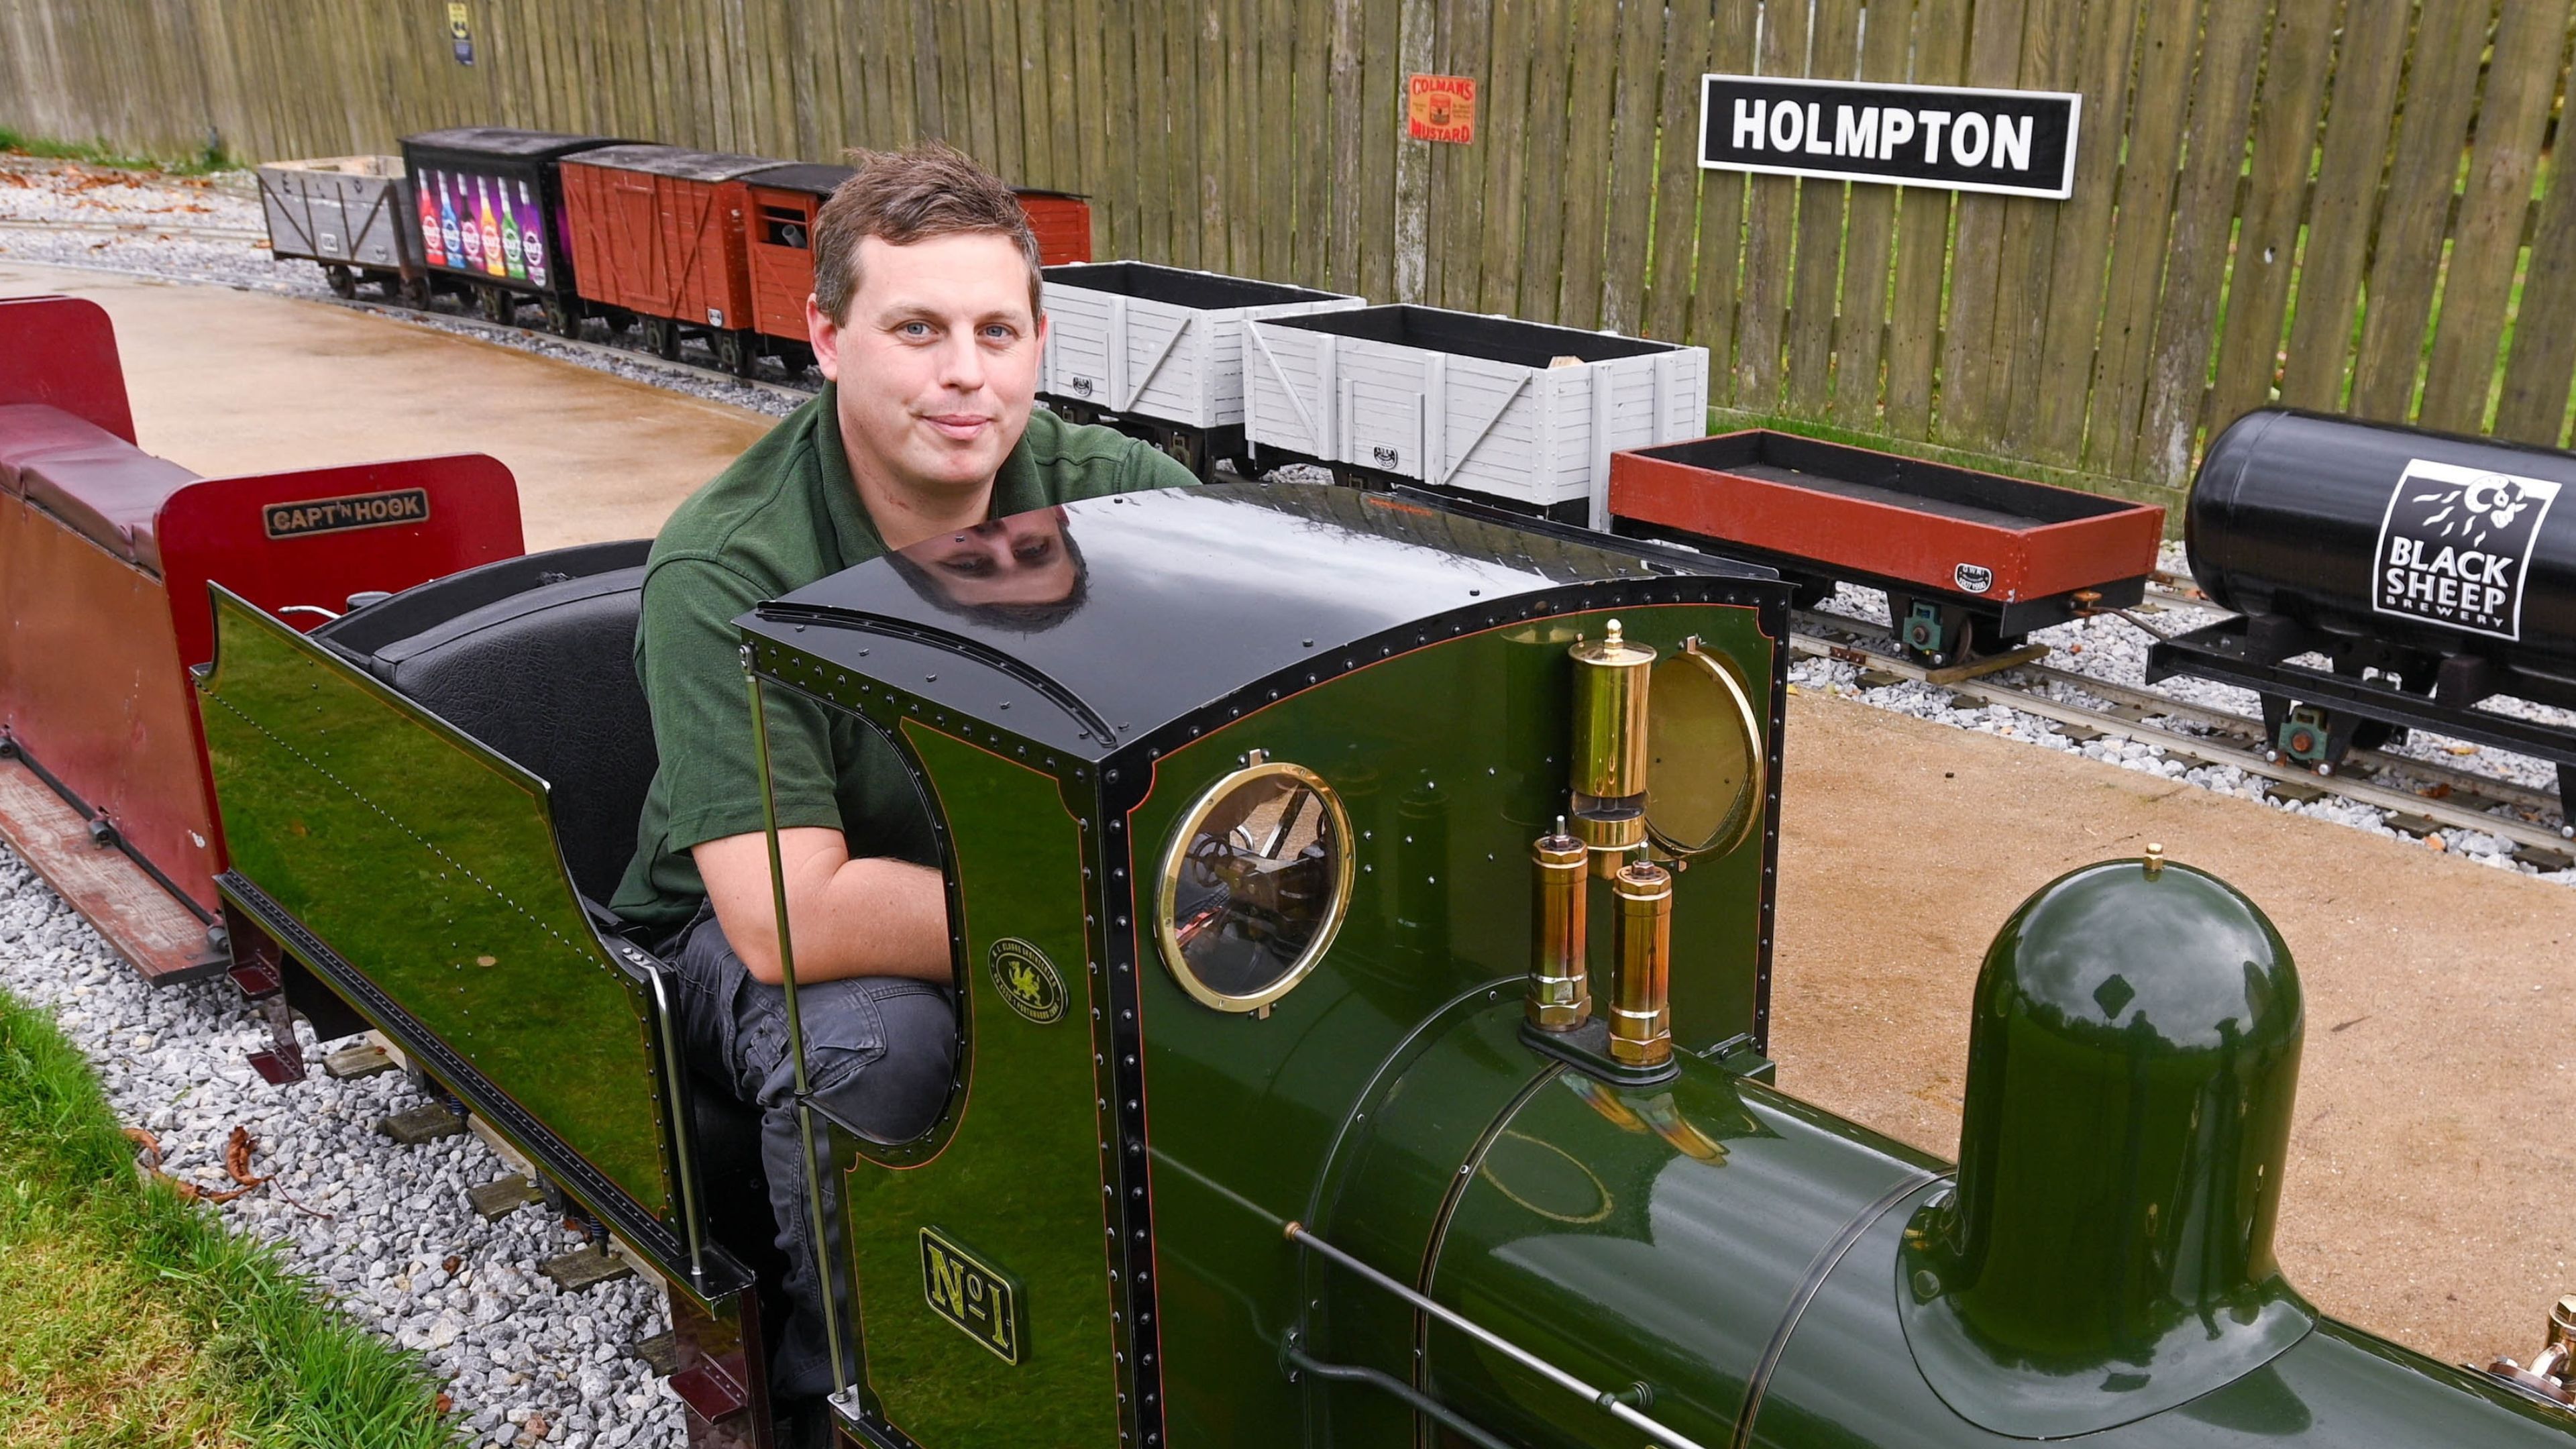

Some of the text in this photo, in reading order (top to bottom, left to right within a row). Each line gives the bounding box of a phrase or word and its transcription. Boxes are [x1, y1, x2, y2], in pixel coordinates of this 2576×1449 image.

[1411, 117, 1470, 143] MUSTARD
[1732, 98, 2034, 172] HOLMPTON
[272, 496, 421, 531] CAPT'N HOOK
[2389, 535, 2514, 588] BLACK
[2385, 568, 2507, 614] SHEEP
[2385, 595, 2504, 628] BREWERY
